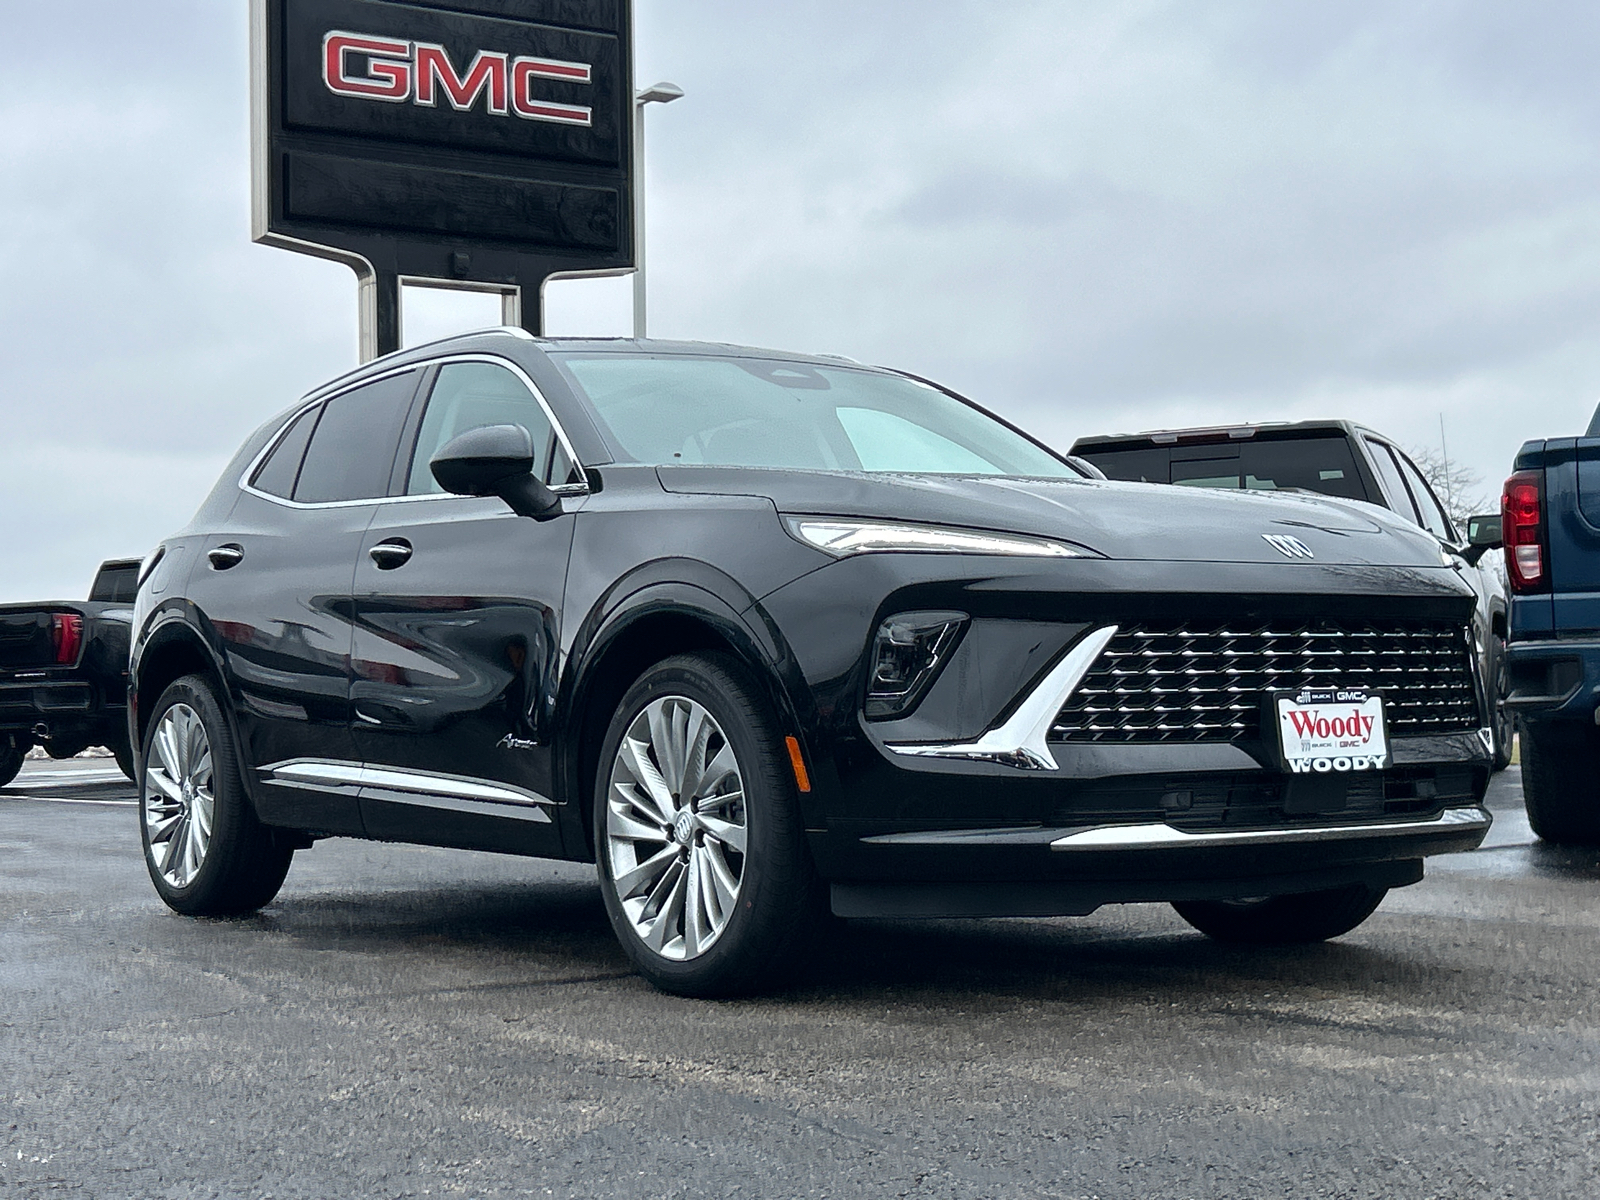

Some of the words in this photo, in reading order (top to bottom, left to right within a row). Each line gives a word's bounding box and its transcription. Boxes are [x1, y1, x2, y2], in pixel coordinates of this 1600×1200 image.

[321, 29, 593, 127] GMC
[1336, 691, 1362, 701] GMC
[1287, 708, 1375, 744] Woody
[1339, 740, 1360, 748] GMC
[1288, 755, 1386, 773] WOODY
